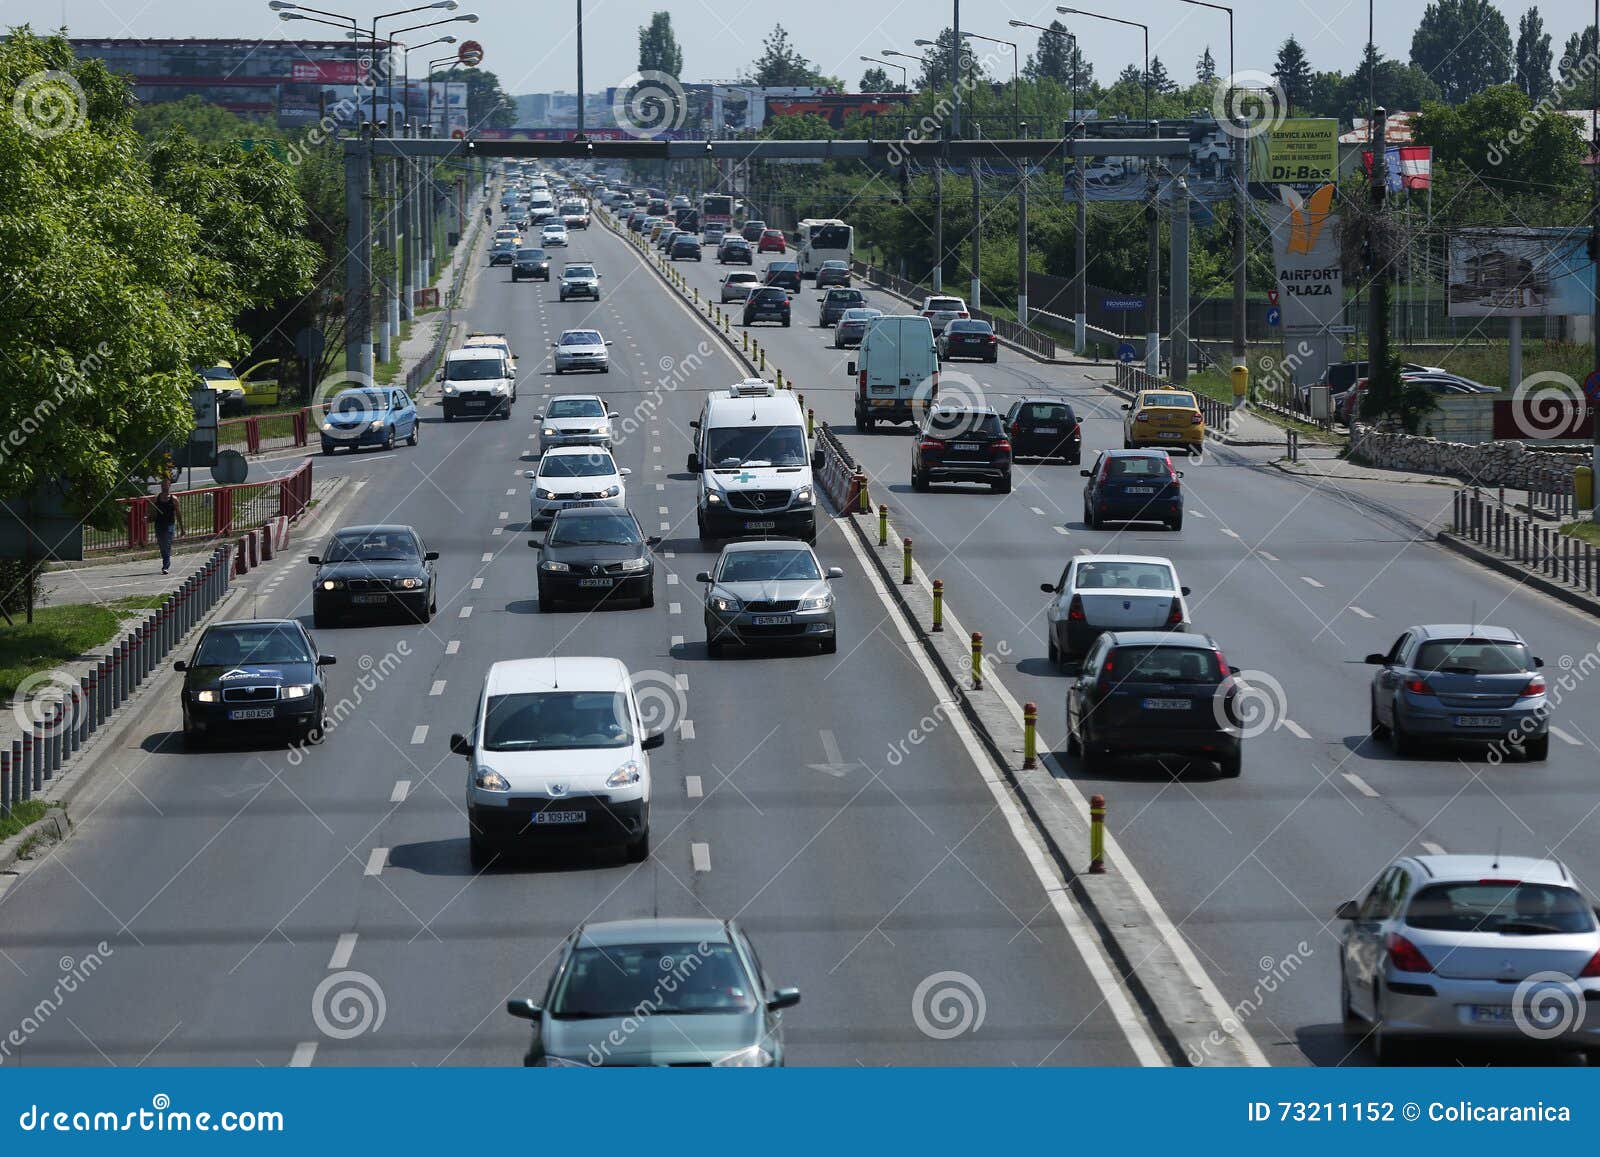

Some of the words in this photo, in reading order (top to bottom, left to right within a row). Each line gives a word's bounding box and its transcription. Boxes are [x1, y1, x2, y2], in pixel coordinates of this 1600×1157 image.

[1272, 165, 1331, 179] Di-Bas
[1280, 268, 1341, 280] AIRPORT
[1286, 284, 1332, 296] PLAZA
